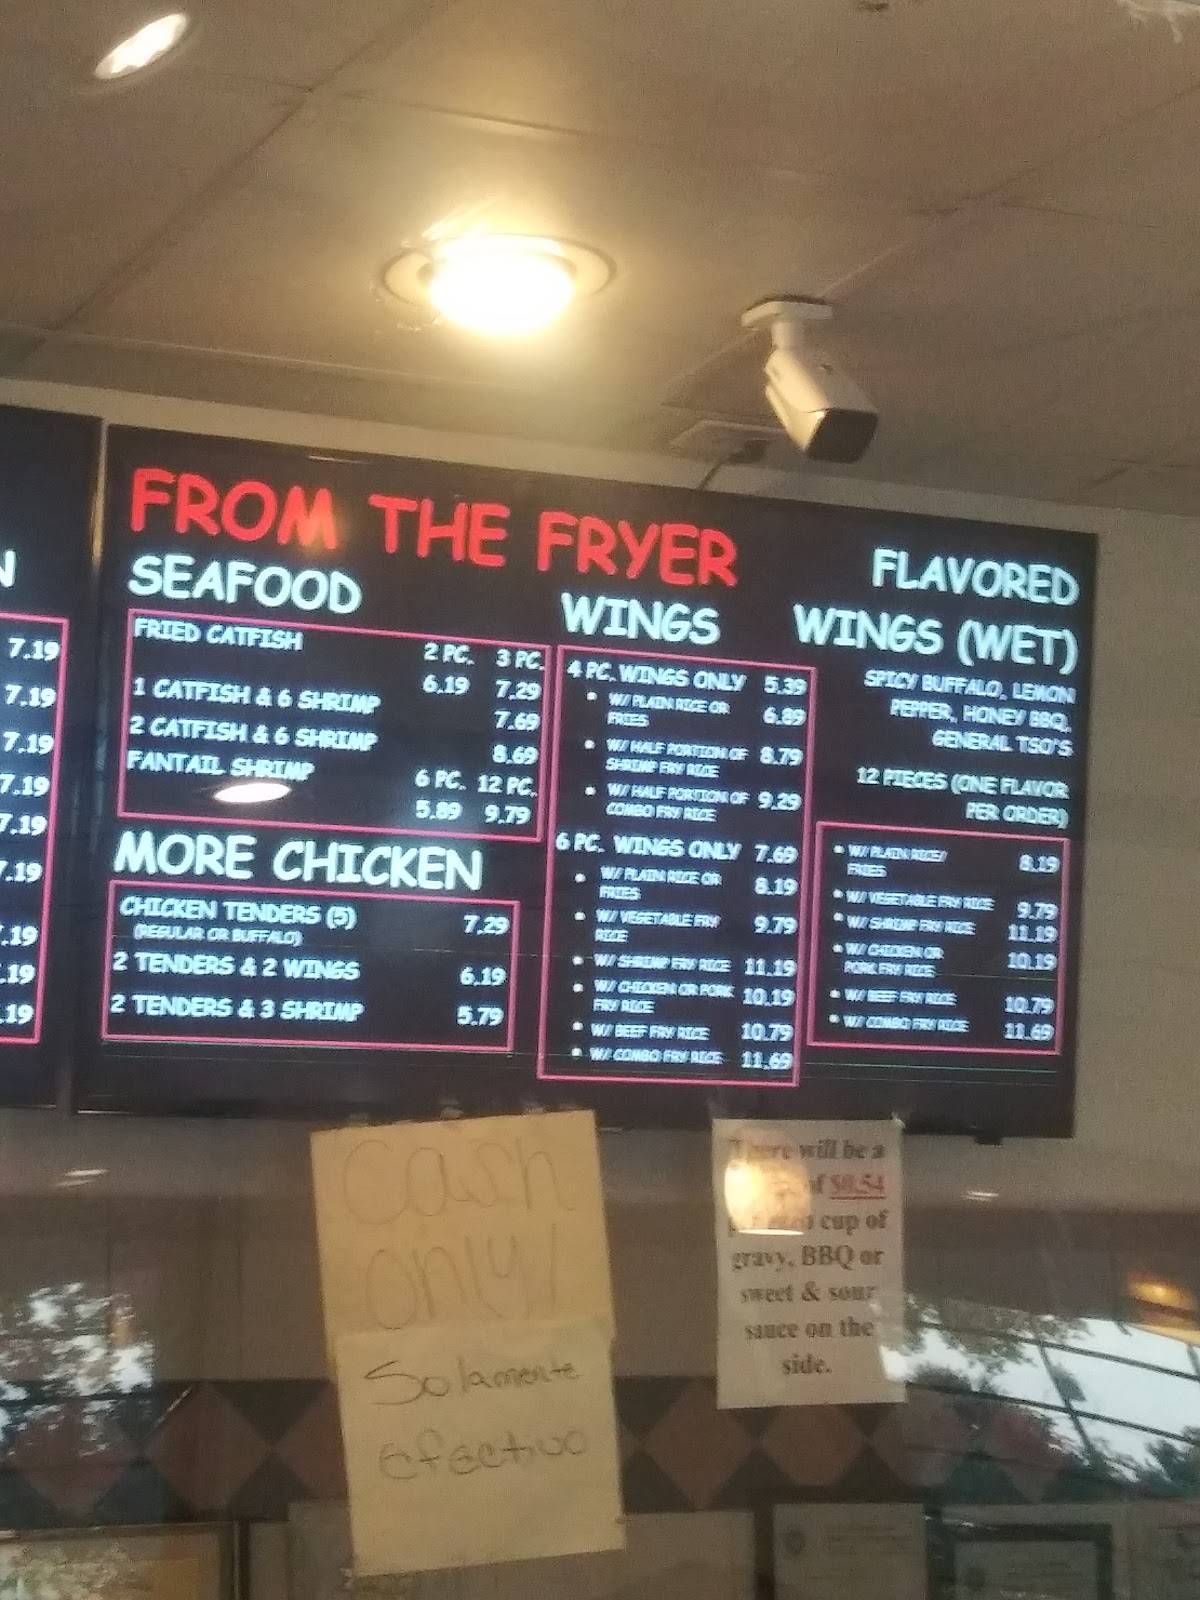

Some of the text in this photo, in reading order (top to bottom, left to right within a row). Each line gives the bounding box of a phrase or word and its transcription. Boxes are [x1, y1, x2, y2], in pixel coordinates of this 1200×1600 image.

[130, 468, 738, 586] FROM THE FRYER
[128, 555, 361, 614] SEAFOOD
[872, 548, 1079, 606] FLAVORED
[561, 592, 720, 644] WINGS
[134, 617, 303, 650] FRIED CATFISH
[793, 604, 1078, 675] WINGS (WET)
[8, 638, 60, 661] 7.19
[424, 643, 475, 665] 2 PC.
[496, 649, 546, 671] 3 PC.
[423, 675, 470, 695] 6.19
[567, 660, 747, 692] 4 PC. WINGS ONLY
[5, 684, 57, 708] 7.19
[133, 677, 381, 714] 1 CATFISH & 6 SHRIMP
[496, 679, 542, 700] 7.29
[494, 710, 540, 731] 7.69
[3, 731, 54, 754] 7.19
[129, 716, 378, 751] 2 CATFISH & 6 SHRIMP
[127, 750, 315, 780] FANTAIL SHRIMP
[492, 745, 539, 764] 8.69
[760, 747, 803, 766] 8.79
[0, 773, 50, 797] 7.19
[415, 769, 467, 790] 6 PC.
[478, 775, 538, 797] 12 PC.
[416, 800, 463, 820] 5.89
[485, 805, 532, 824] 9.79
[556, 832, 742, 861] 6 PC. WINGS ONLY
[113, 830, 483, 891] MORE CHICKEN
[754, 877, 798, 896] 8.19
[119, 896, 357, 931] CHICKEN TENDERS (5)
[463, 915, 509, 935] 7.29
[754, 915, 797, 935] 9.79
[112, 953, 361, 980] 2 TENDERS & 2 WINGS
[459, 967, 507, 987] 6.19
[745, 958, 797, 977] 11.19
[743, 988, 796, 1007] 10.19
[110, 995, 365, 1023] 2 TENDERS & 3 SHRIMP
[457, 1006, 503, 1026] 5.79
[799, 1139, 885, 1159] will be a
[820, 1214, 859, 1235] cup
[866, 1209, 888, 1229] of
[801, 1245, 855, 1270] BBQ
[859, 1250, 885, 1266] or
[802, 1281, 821, 1301] &
[805, 1323, 832, 1337] on
[839, 1316, 874, 1337] the
